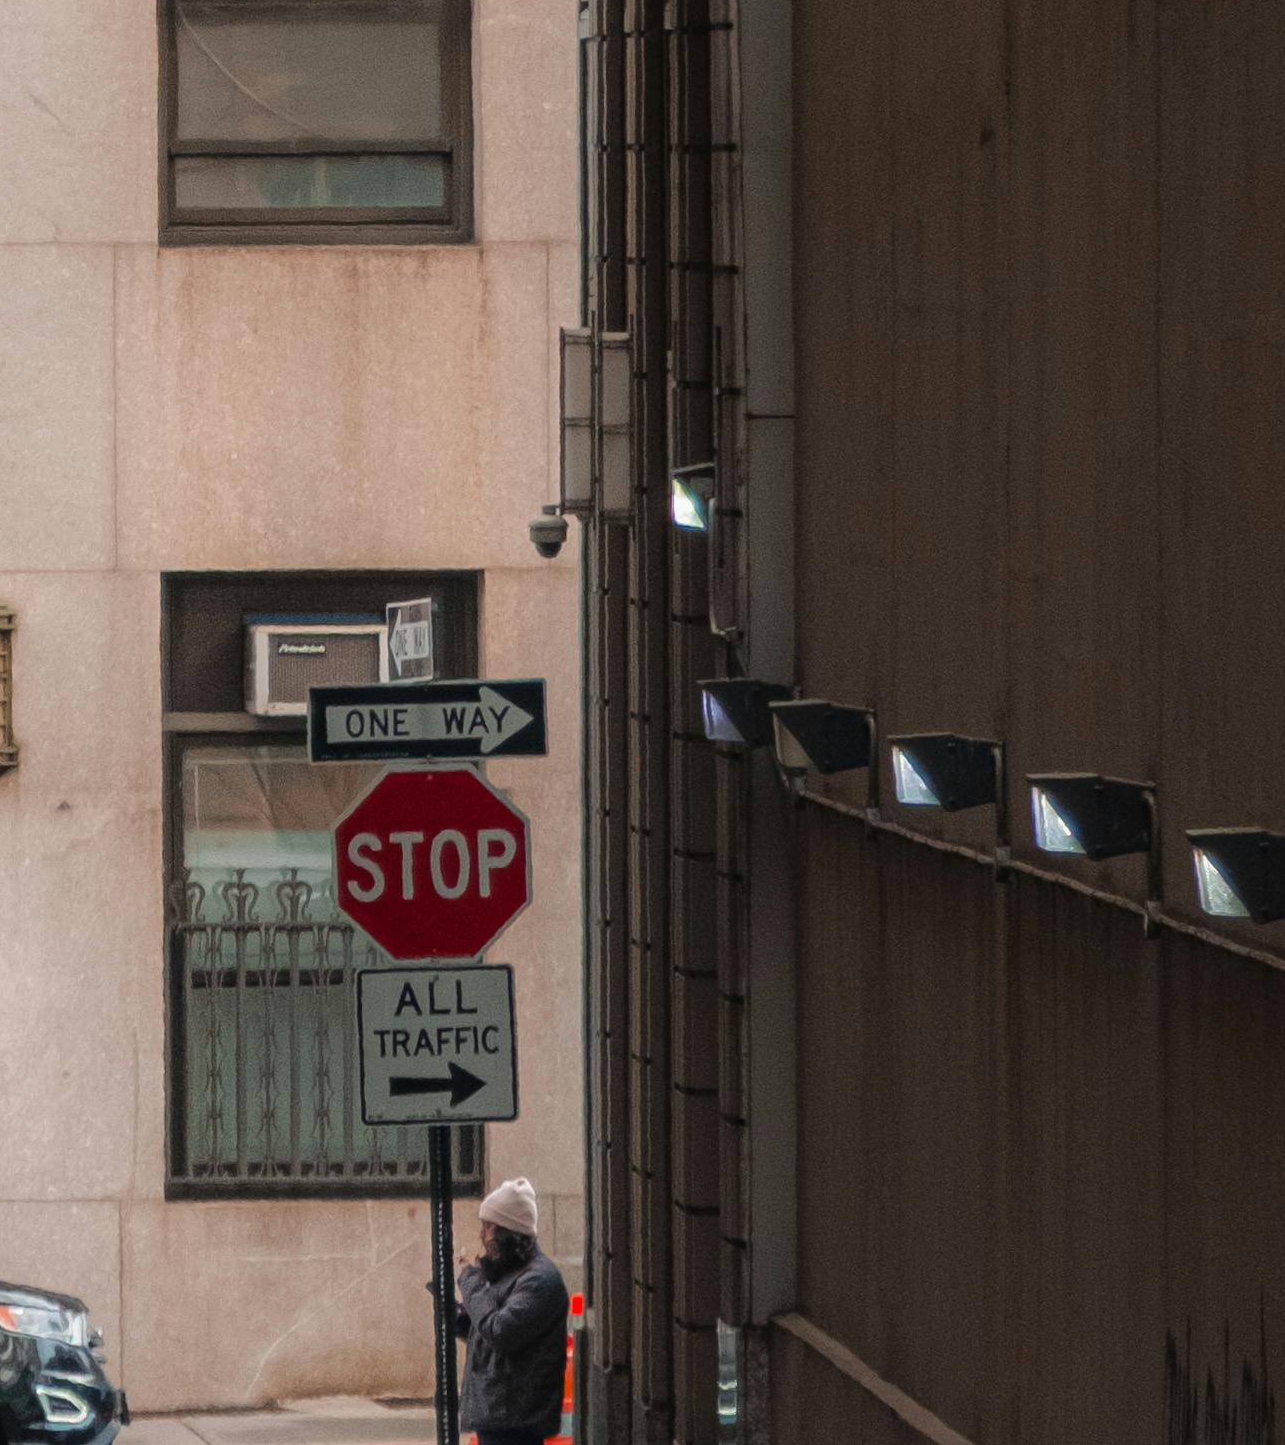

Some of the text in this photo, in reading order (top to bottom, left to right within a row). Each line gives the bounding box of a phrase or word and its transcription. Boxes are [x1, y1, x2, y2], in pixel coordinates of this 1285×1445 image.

[345, 705, 510, 738] ONE WAY
[346, 827, 518, 904] STOP
[394, 978, 479, 1017] ALL
[373, 1024, 500, 1059] TRAFFIC
